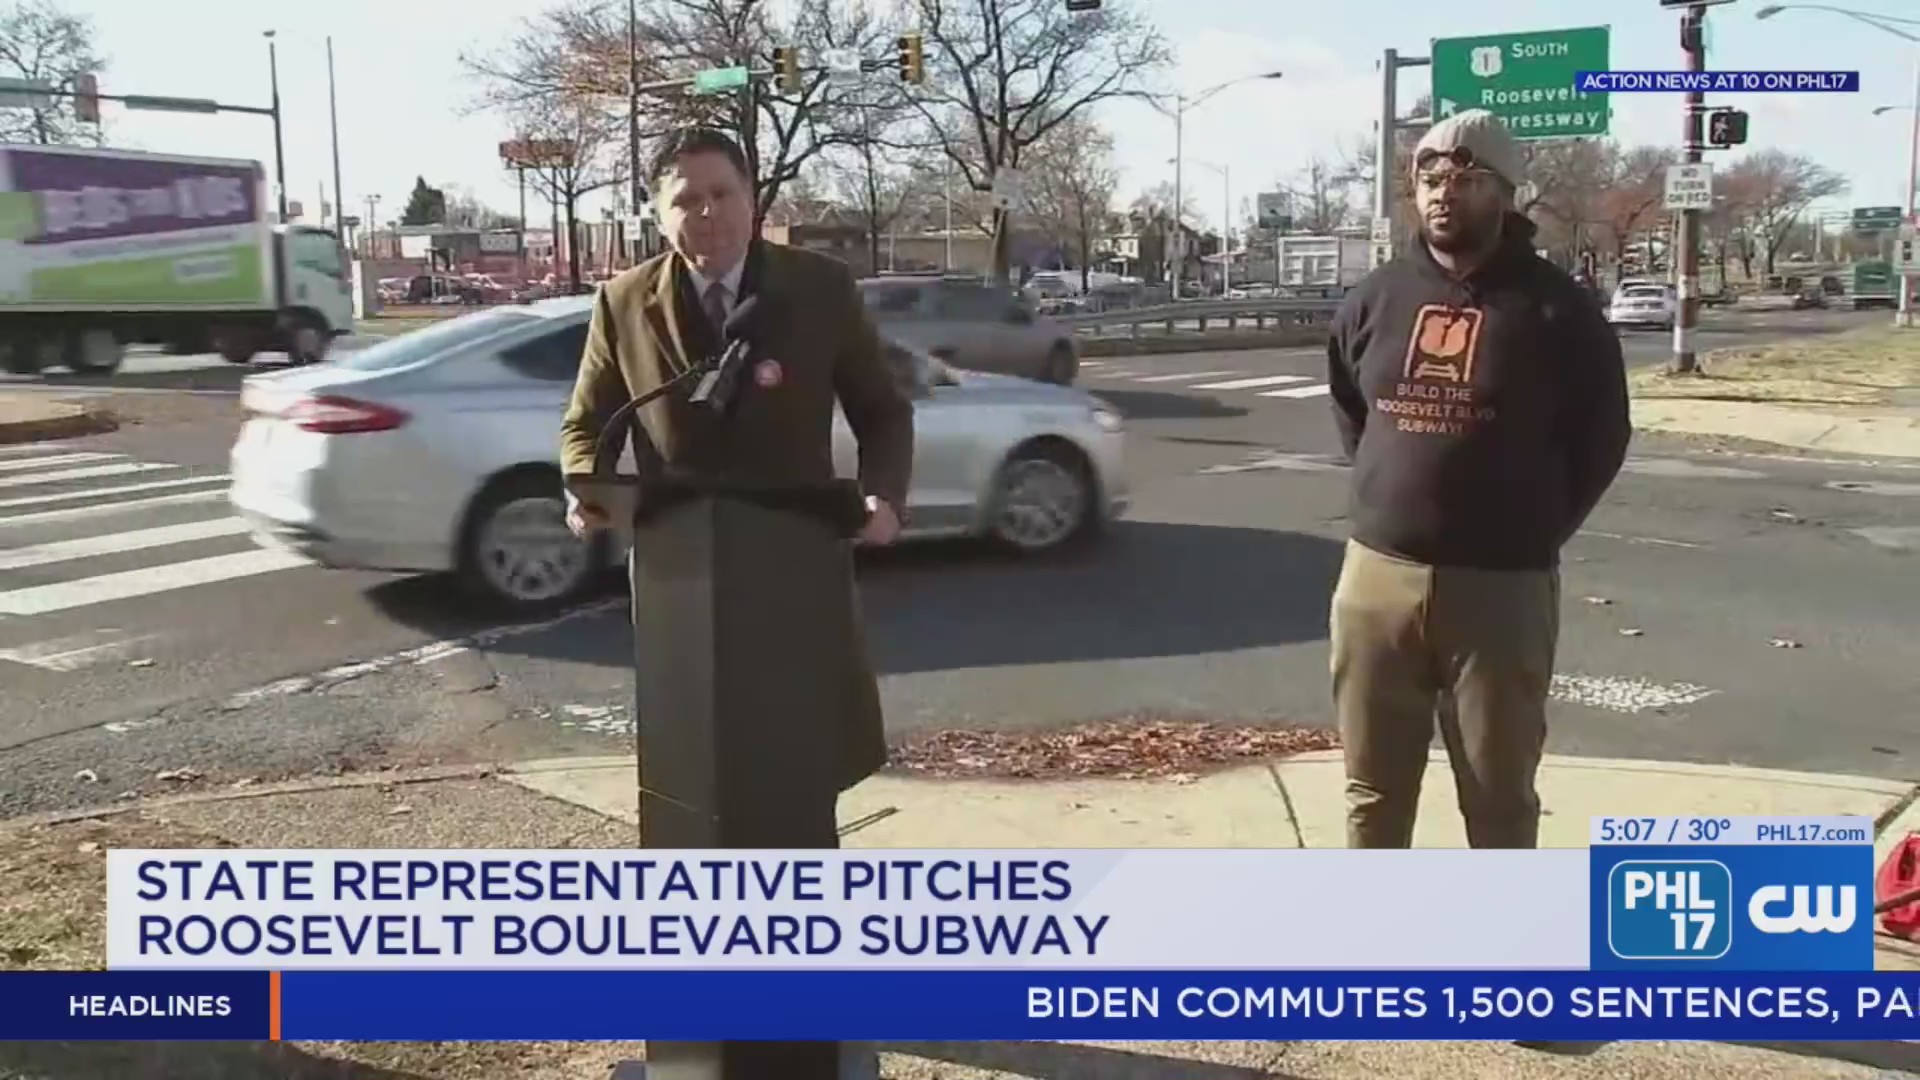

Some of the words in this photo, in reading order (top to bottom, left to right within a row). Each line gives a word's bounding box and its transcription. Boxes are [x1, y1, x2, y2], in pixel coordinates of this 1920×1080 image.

[1511, 42, 1569, 58] SOUTH
[1397, 383, 1440, 399] BUILD
[1444, 387, 1474, 402] THE
[1376, 398, 1453, 418] ROOSEVELT
